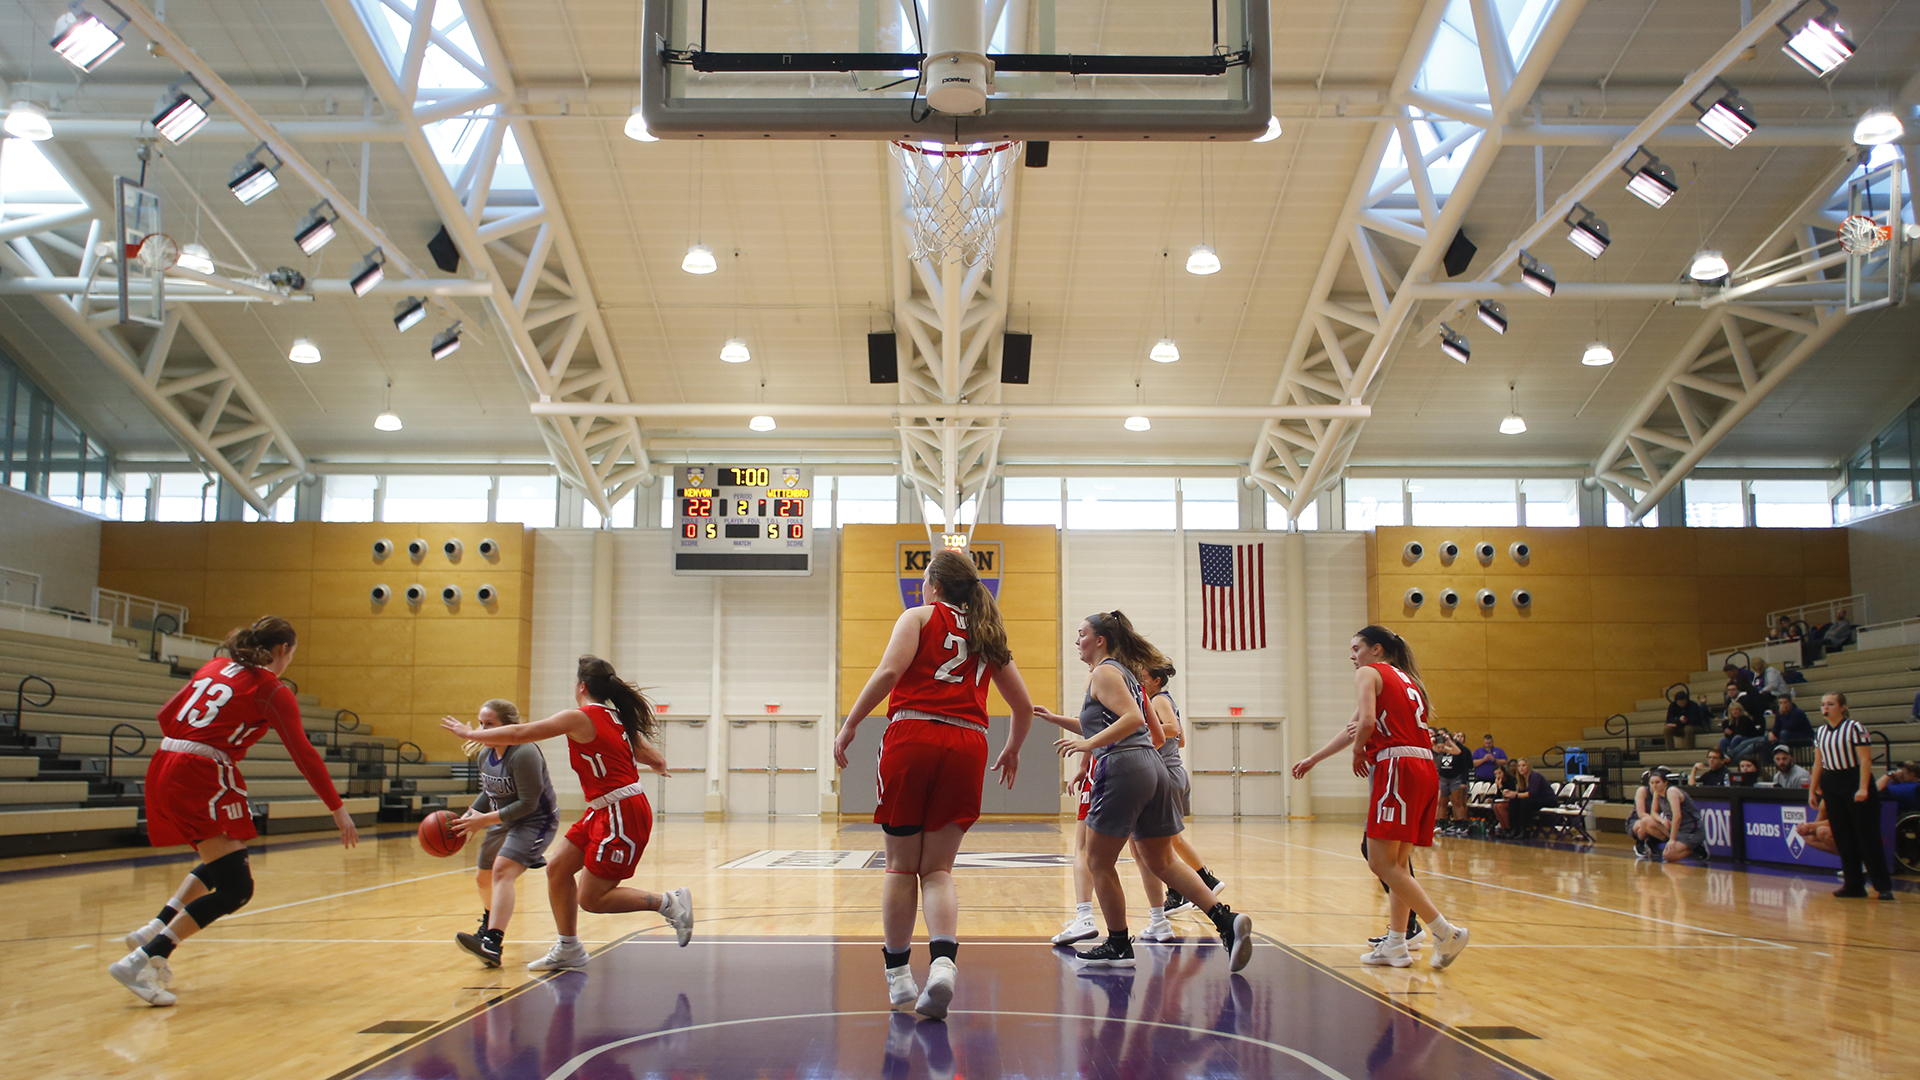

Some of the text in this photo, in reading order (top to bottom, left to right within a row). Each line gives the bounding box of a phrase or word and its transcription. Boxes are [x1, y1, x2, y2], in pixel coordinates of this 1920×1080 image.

[942, 76, 971, 84] porter
[730, 467, 769, 487] 7:00
[683, 488, 713, 498] KENYON
[687, 498, 711, 517] 22
[737, 500, 748, 515] 2
[779, 498, 803, 517] 27
[686, 523, 697, 539] 0
[706, 523, 717, 539] 5
[768, 523, 779, 539] 5
[791, 523, 803, 539] 0
[941, 534, 967, 547] 7:00
[176, 676, 234, 728] 13
[1230, 707, 1242, 716] EXIT
[1783, 811, 1805, 820] KENYON
[1746, 822, 1781, 837] LORDS
